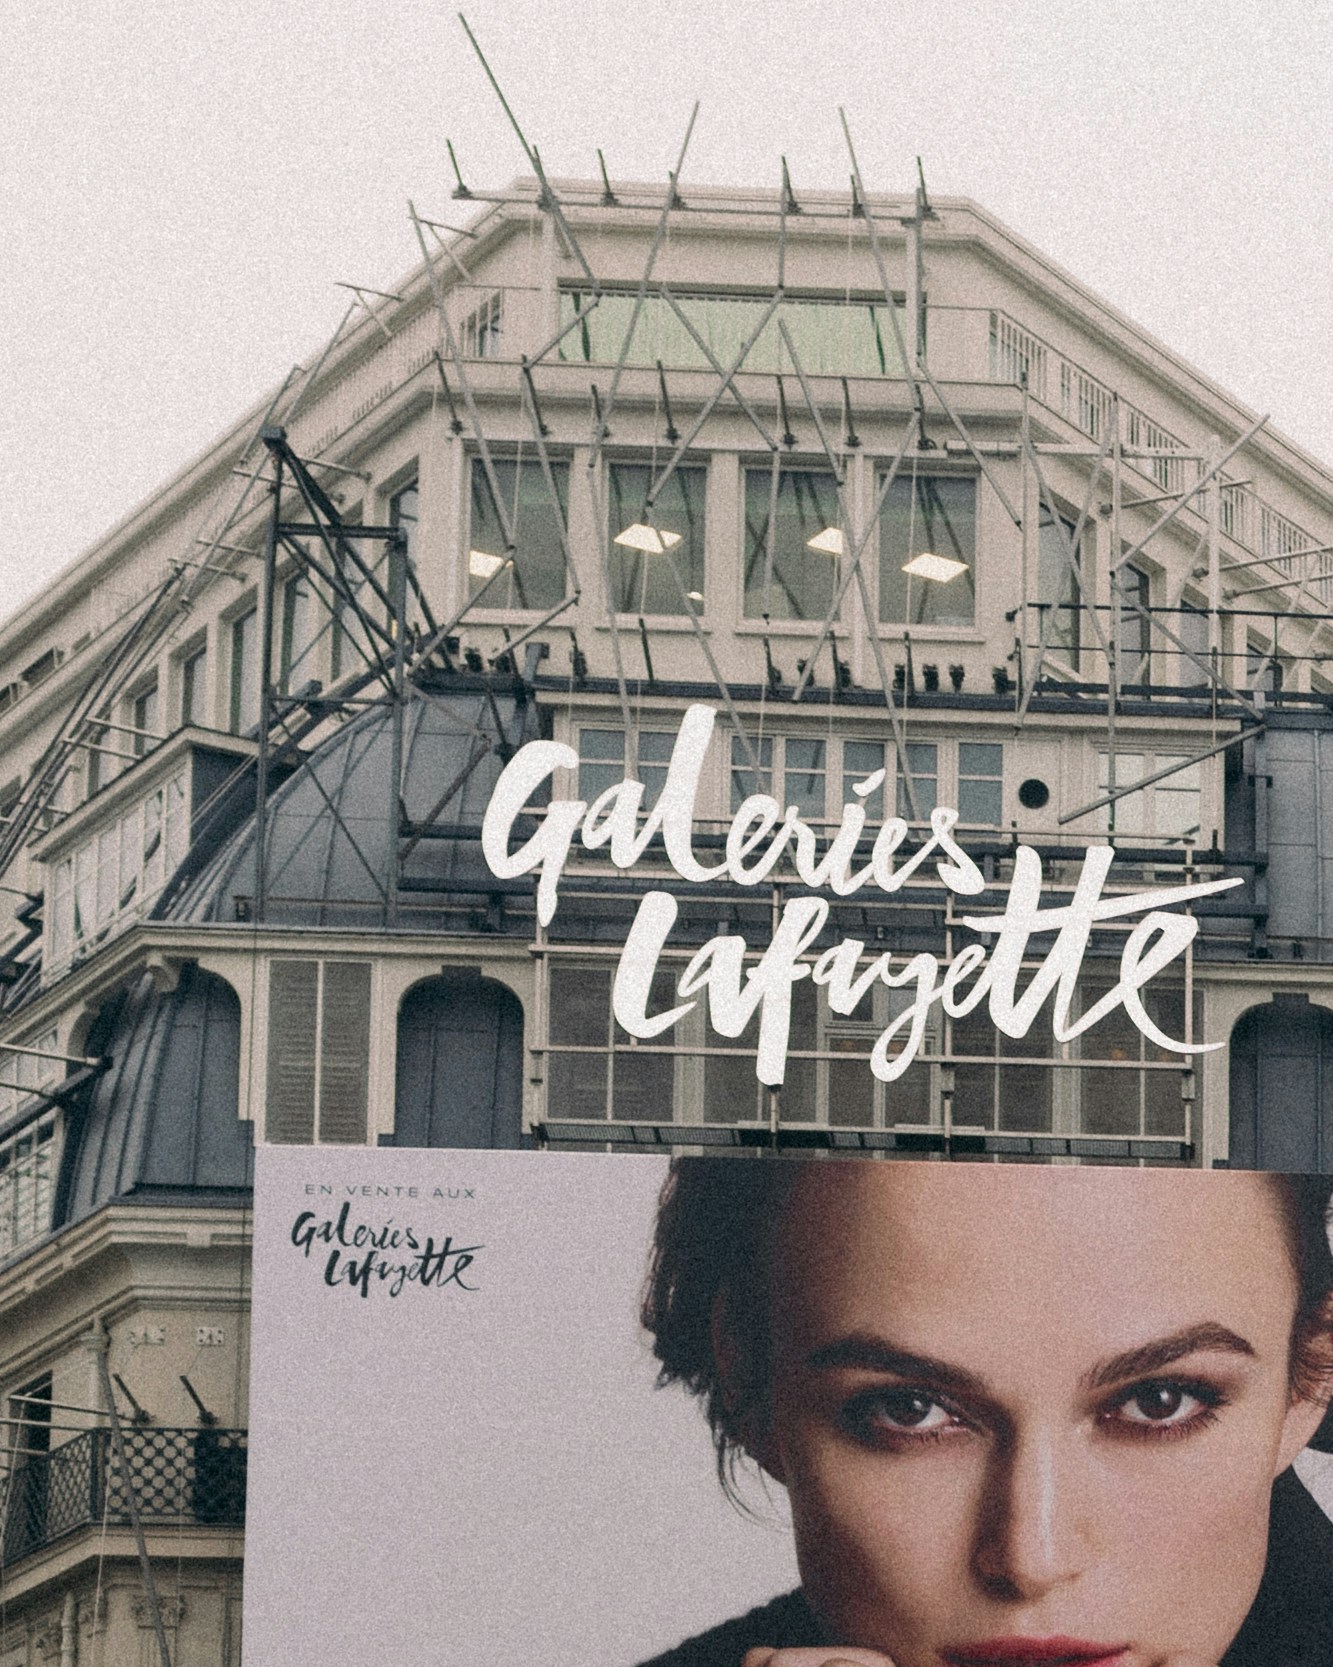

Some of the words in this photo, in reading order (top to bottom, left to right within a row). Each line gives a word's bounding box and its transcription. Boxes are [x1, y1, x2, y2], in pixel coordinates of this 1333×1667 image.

[481, 703, 985, 927] Galeries
[612, 844, 1245, 1086] Lafayette
[304, 1184, 333, 1196] EN
[345, 1185, 419, 1198] VENTE
[432, 1187, 477, 1199] AUX
[290, 1200, 420, 1258] Galeries
[323, 1236, 487, 1299] Lafayette
